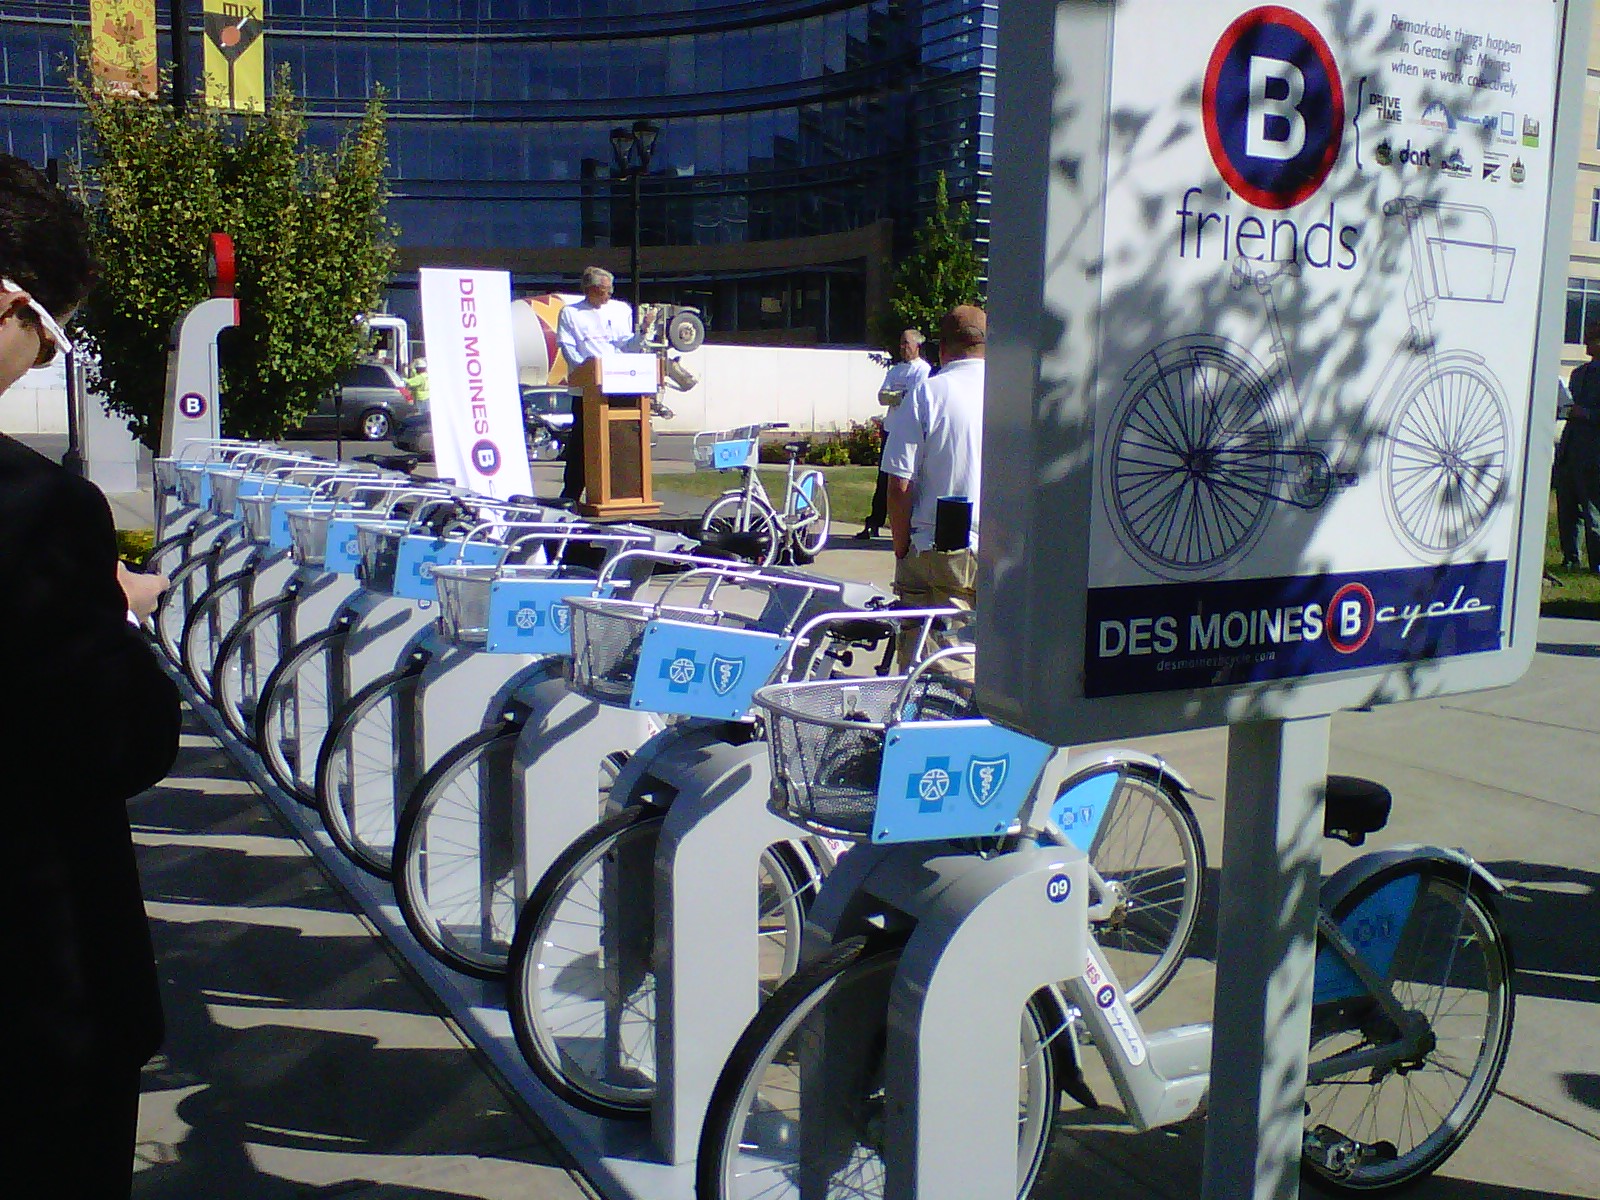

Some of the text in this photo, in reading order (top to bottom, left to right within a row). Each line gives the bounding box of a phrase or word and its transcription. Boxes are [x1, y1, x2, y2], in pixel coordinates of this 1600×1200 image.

[223, 2, 257, 19] mix
[1390, 13, 1522, 56] Remarkable things happen
[1413, 39, 1450, 60] Greater
[1455, 47, 1473, 66] Des
[1477, 52, 1511, 73] Moines
[1391, 59, 1419, 76] when
[1422, 67, 1436, 80] we
[1440, 68, 1464, 85] work
[1246, 55, 1306, 161] B
[1369, 92, 1401, 109] DRIVE
[1377, 106, 1403, 122] TIME
[1399, 138, 1431, 167] dart
[1176, 187, 1358, 270] friends
[459, 278, 477, 329] DES
[464, 336, 489, 435] MOINES
[186, 396, 200, 414] B
[1098, 585, 1495, 658] DES MOINES B cycle
[1050, 879, 1069, 898] 09
